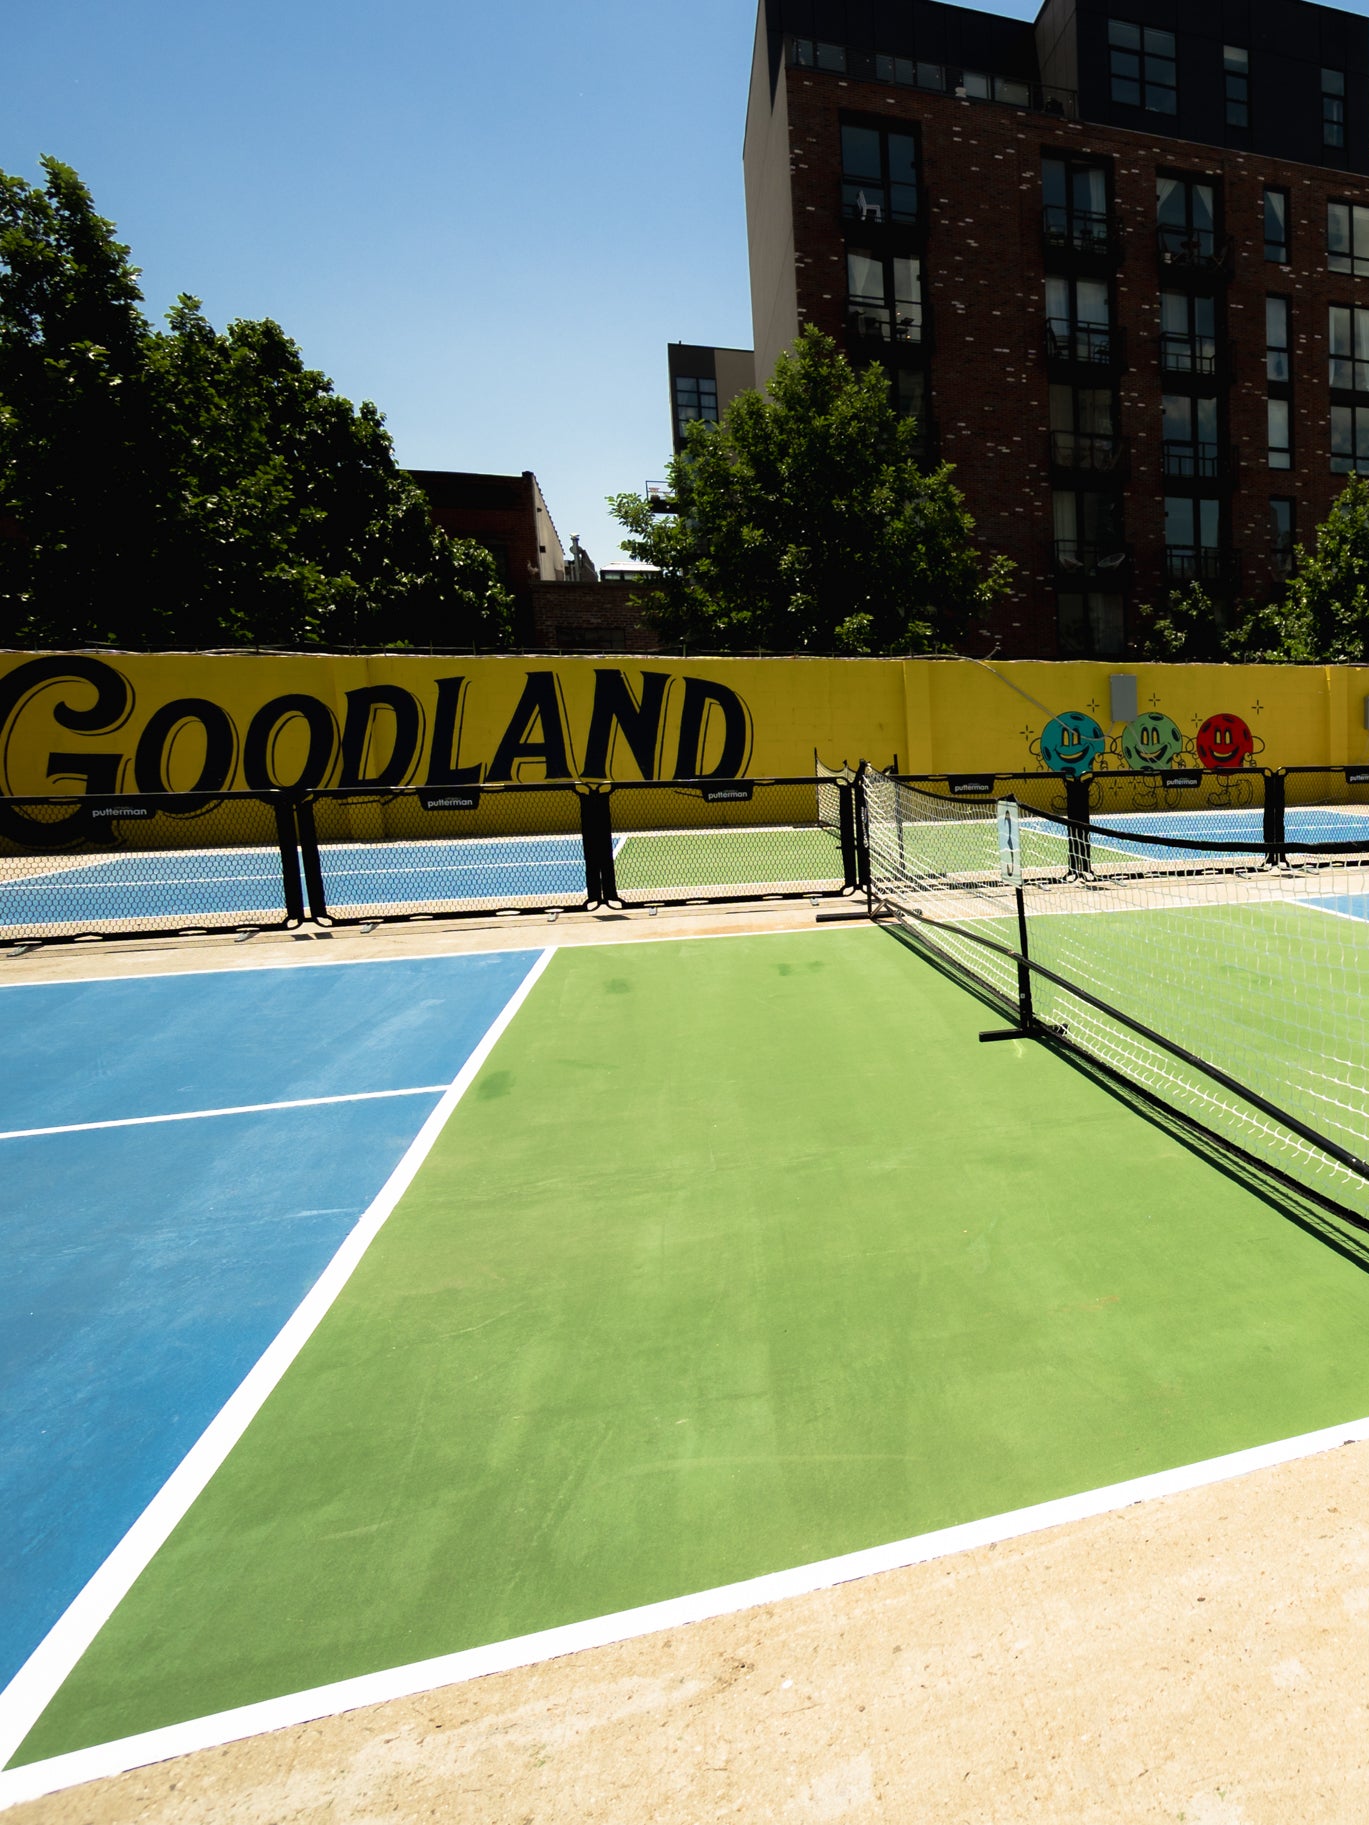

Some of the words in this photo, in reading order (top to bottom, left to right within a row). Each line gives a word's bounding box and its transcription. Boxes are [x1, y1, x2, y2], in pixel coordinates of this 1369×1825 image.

[0, 655, 754, 848] GOODLAND
[708, 791, 748, 800] putterman
[427, 799, 473, 808] putterman
[92, 808, 147, 818] putterman
